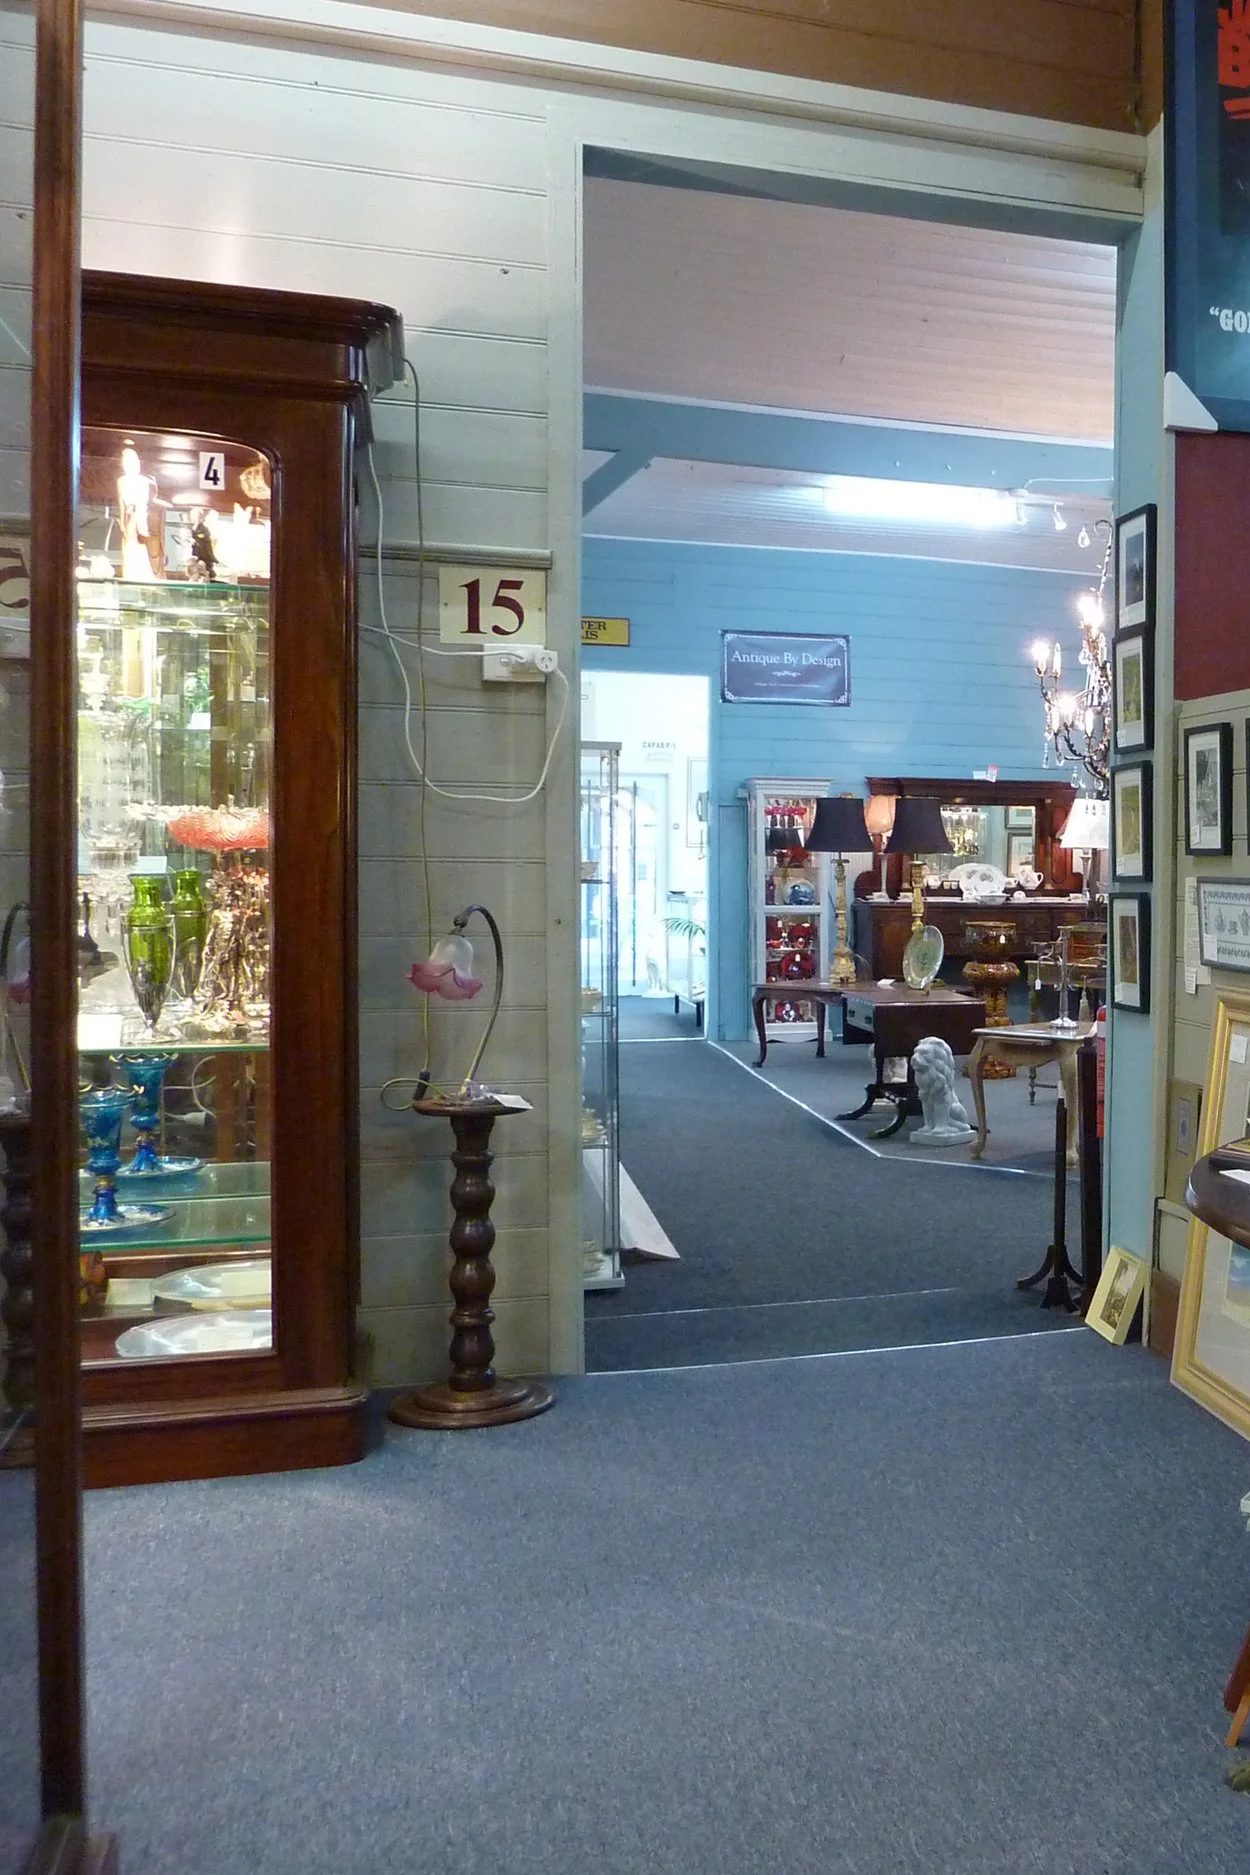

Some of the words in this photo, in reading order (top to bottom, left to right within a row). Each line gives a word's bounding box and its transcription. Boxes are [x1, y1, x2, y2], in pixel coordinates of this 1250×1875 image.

[204, 456, 221, 486] 4
[458, 578, 525, 636] 15
[731, 650, 780, 667] Antique
[783, 652, 799, 667] By
[802, 652, 842, 669] Design
